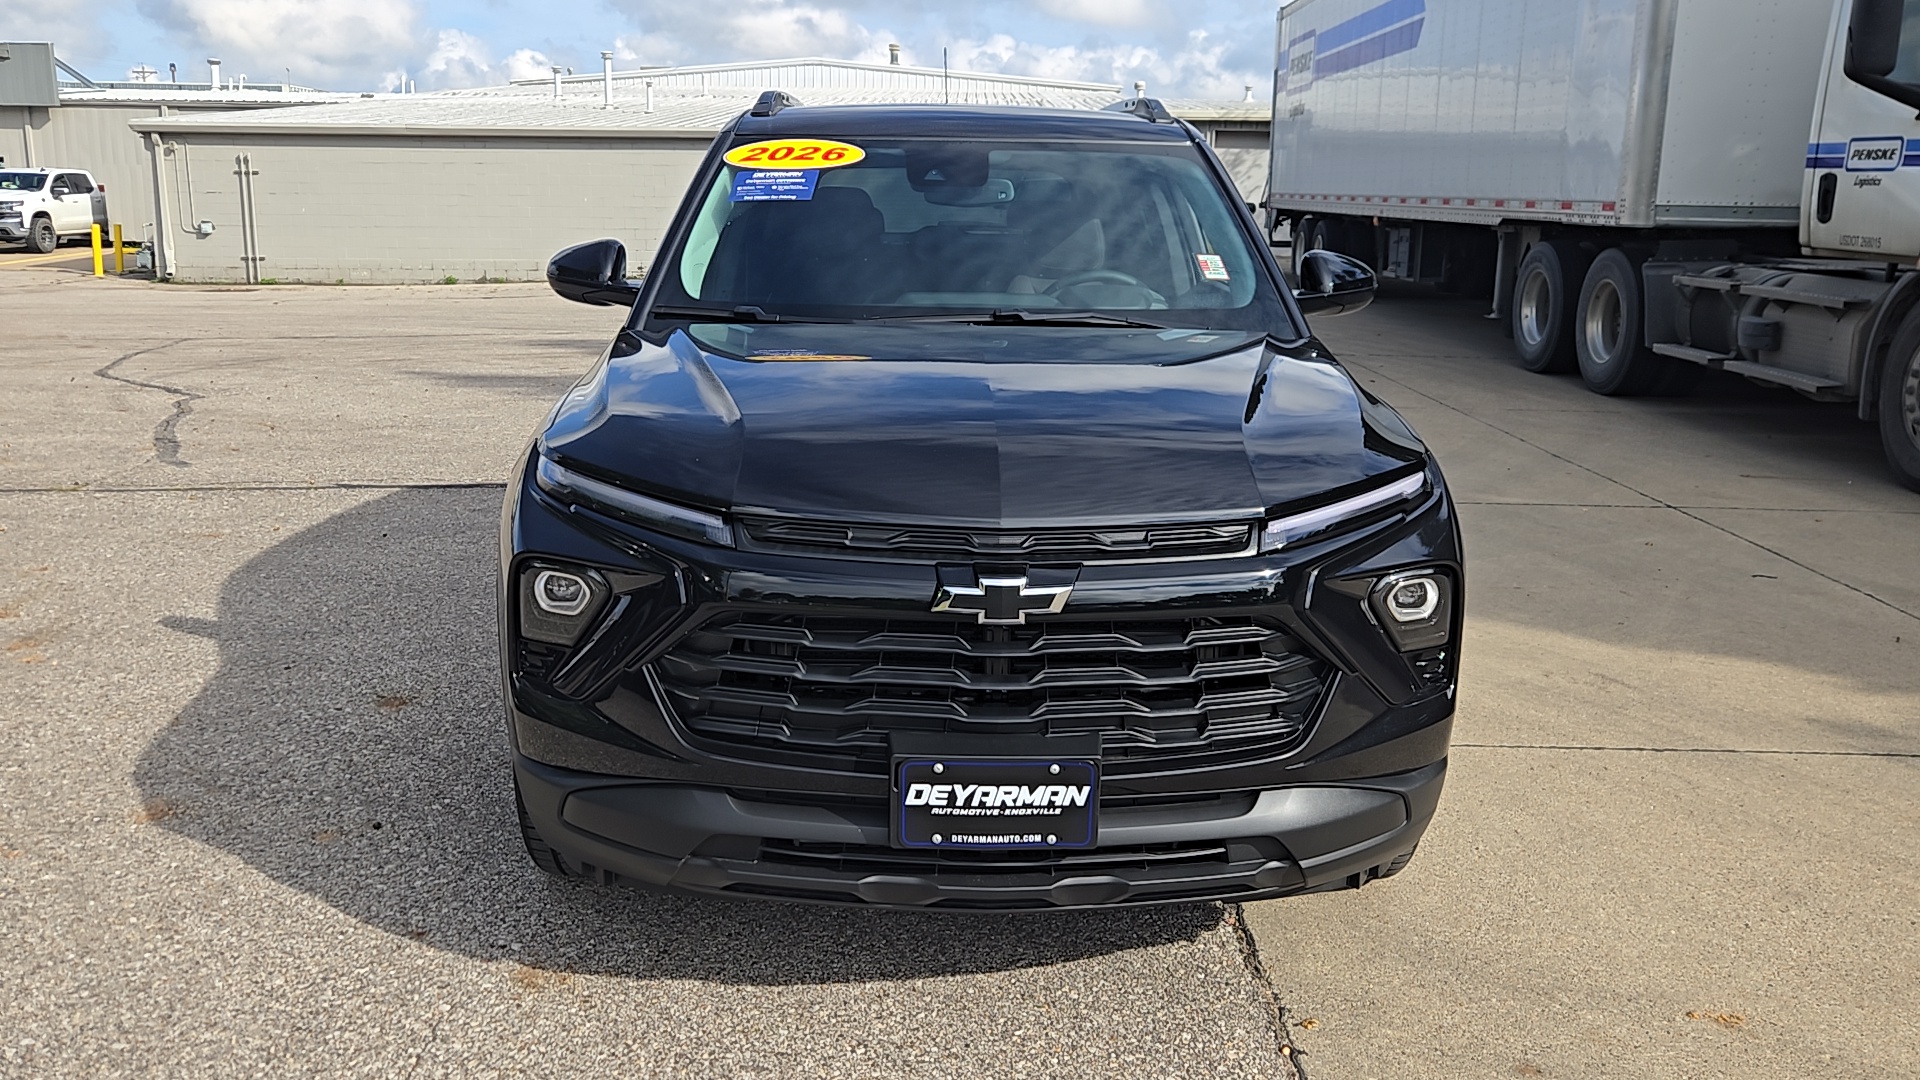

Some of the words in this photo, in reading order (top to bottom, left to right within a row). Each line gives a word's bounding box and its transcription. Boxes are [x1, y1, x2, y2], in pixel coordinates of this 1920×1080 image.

[738, 146, 849, 162] 2026
[1851, 148, 1898, 161] PENSKE
[1853, 175, 1882, 189] Logistics
[1839, 234, 1860, 247] USDOT
[905, 783, 1091, 807] DEYARMAN
[951, 834, 1042, 844] DEYARMANAUTO.COM
